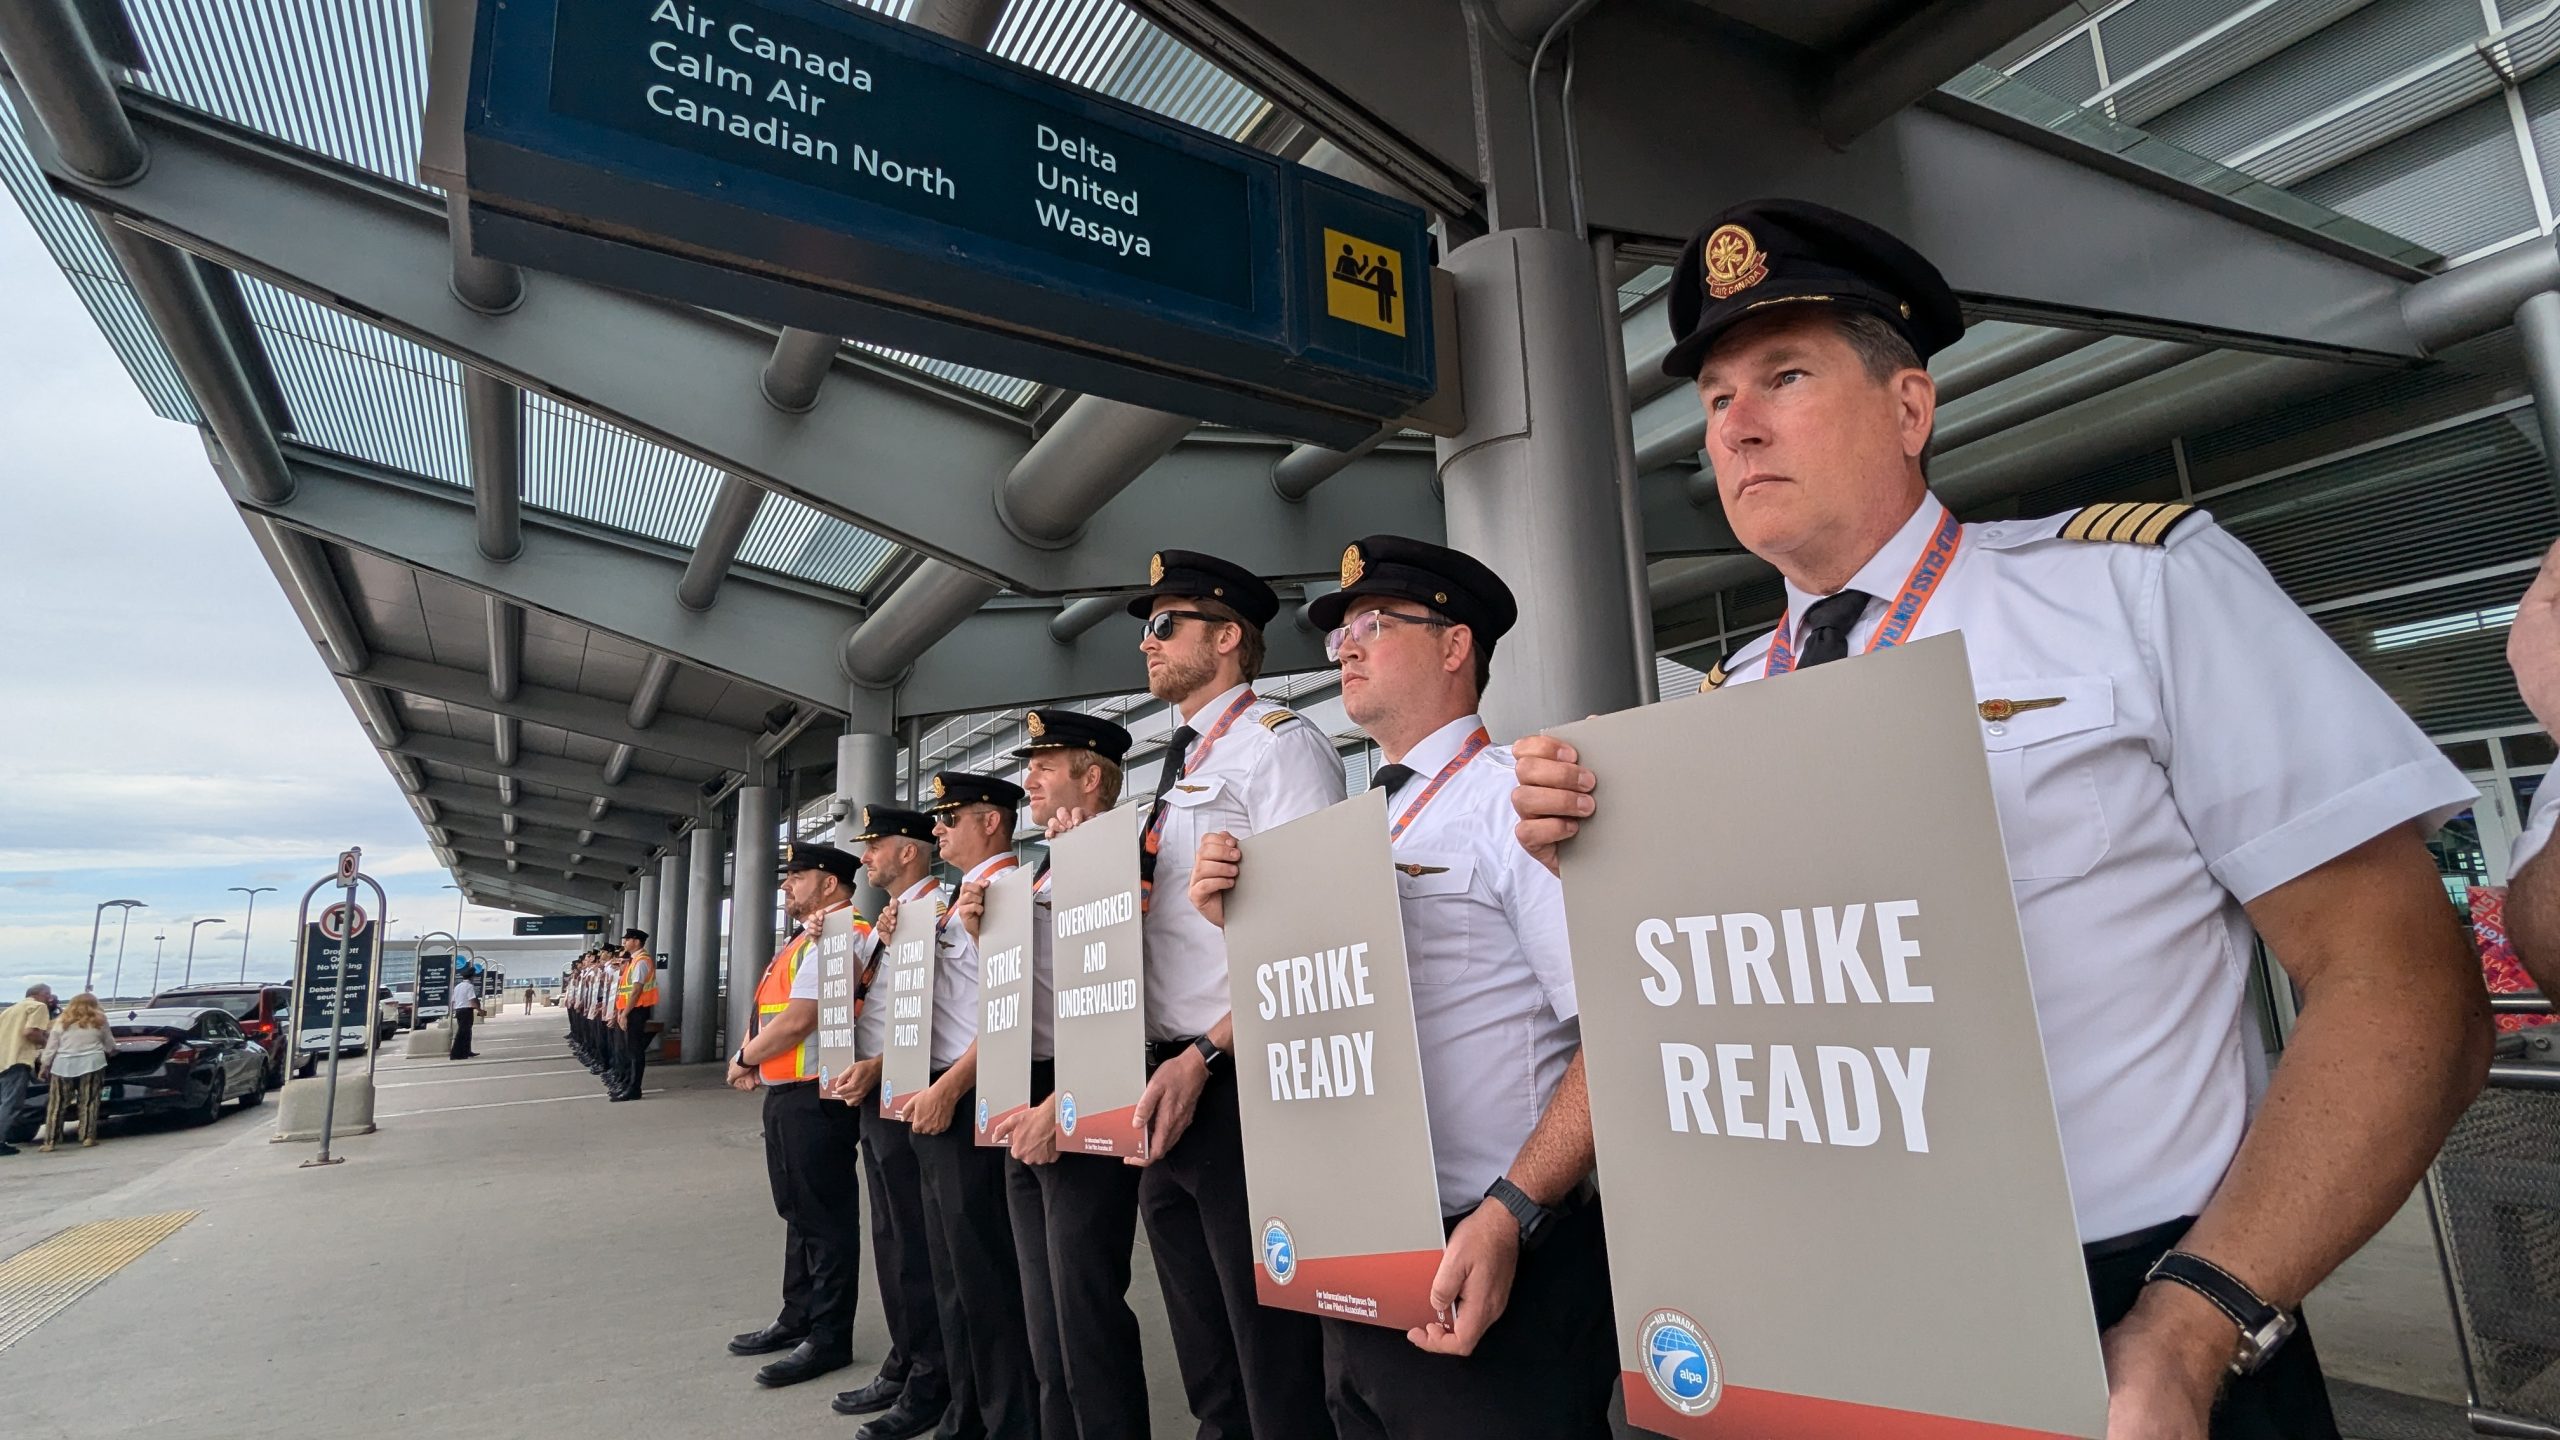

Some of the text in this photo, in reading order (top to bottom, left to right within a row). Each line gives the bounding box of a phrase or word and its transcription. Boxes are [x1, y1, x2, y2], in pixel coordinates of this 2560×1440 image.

[650, 0, 873, 93] Air Canada
[649, 41, 826, 117] Calm Air
[646, 84, 956, 200] Canadian North
[1037, 123, 1117, 173] Delta
[1037, 161, 1139, 217] United
[1035, 199, 1152, 257] Wasaya
[1729, 271, 1760, 295] CANADA
[1872, 592, 1922, 653] CONTRA
[1058, 891, 1132, 938] OVERWORKED
[823, 933, 847, 956] 20 YEARS
[902, 939, 924, 965] STAND
[1083, 941, 1107, 974] AND
[1634, 898, 1935, 1008] STRIKE
[826, 956, 844, 977] UNDER
[894, 967, 925, 993] WITH AIR
[986, 944, 1022, 990] STRIKE
[1255, 941, 1375, 1022] STRIKE
[823, 978, 847, 999] PAY CUTS
[894, 995, 922, 1019] CANADA
[1058, 978, 1137, 1019] UNDERVALUED
[823, 1005, 848, 1026] PAY BACK
[987, 992, 1020, 1034] READY
[819, 1028, 852, 1049] YOUR PILOTS
[894, 1023, 919, 1047] PILOTS
[1266, 1030, 1376, 1102] READY
[1659, 1041, 1933, 1155] READY
[1655, 1313, 1695, 1333] AIR CANADA
[1680, 1369, 1702, 1384] alpa
